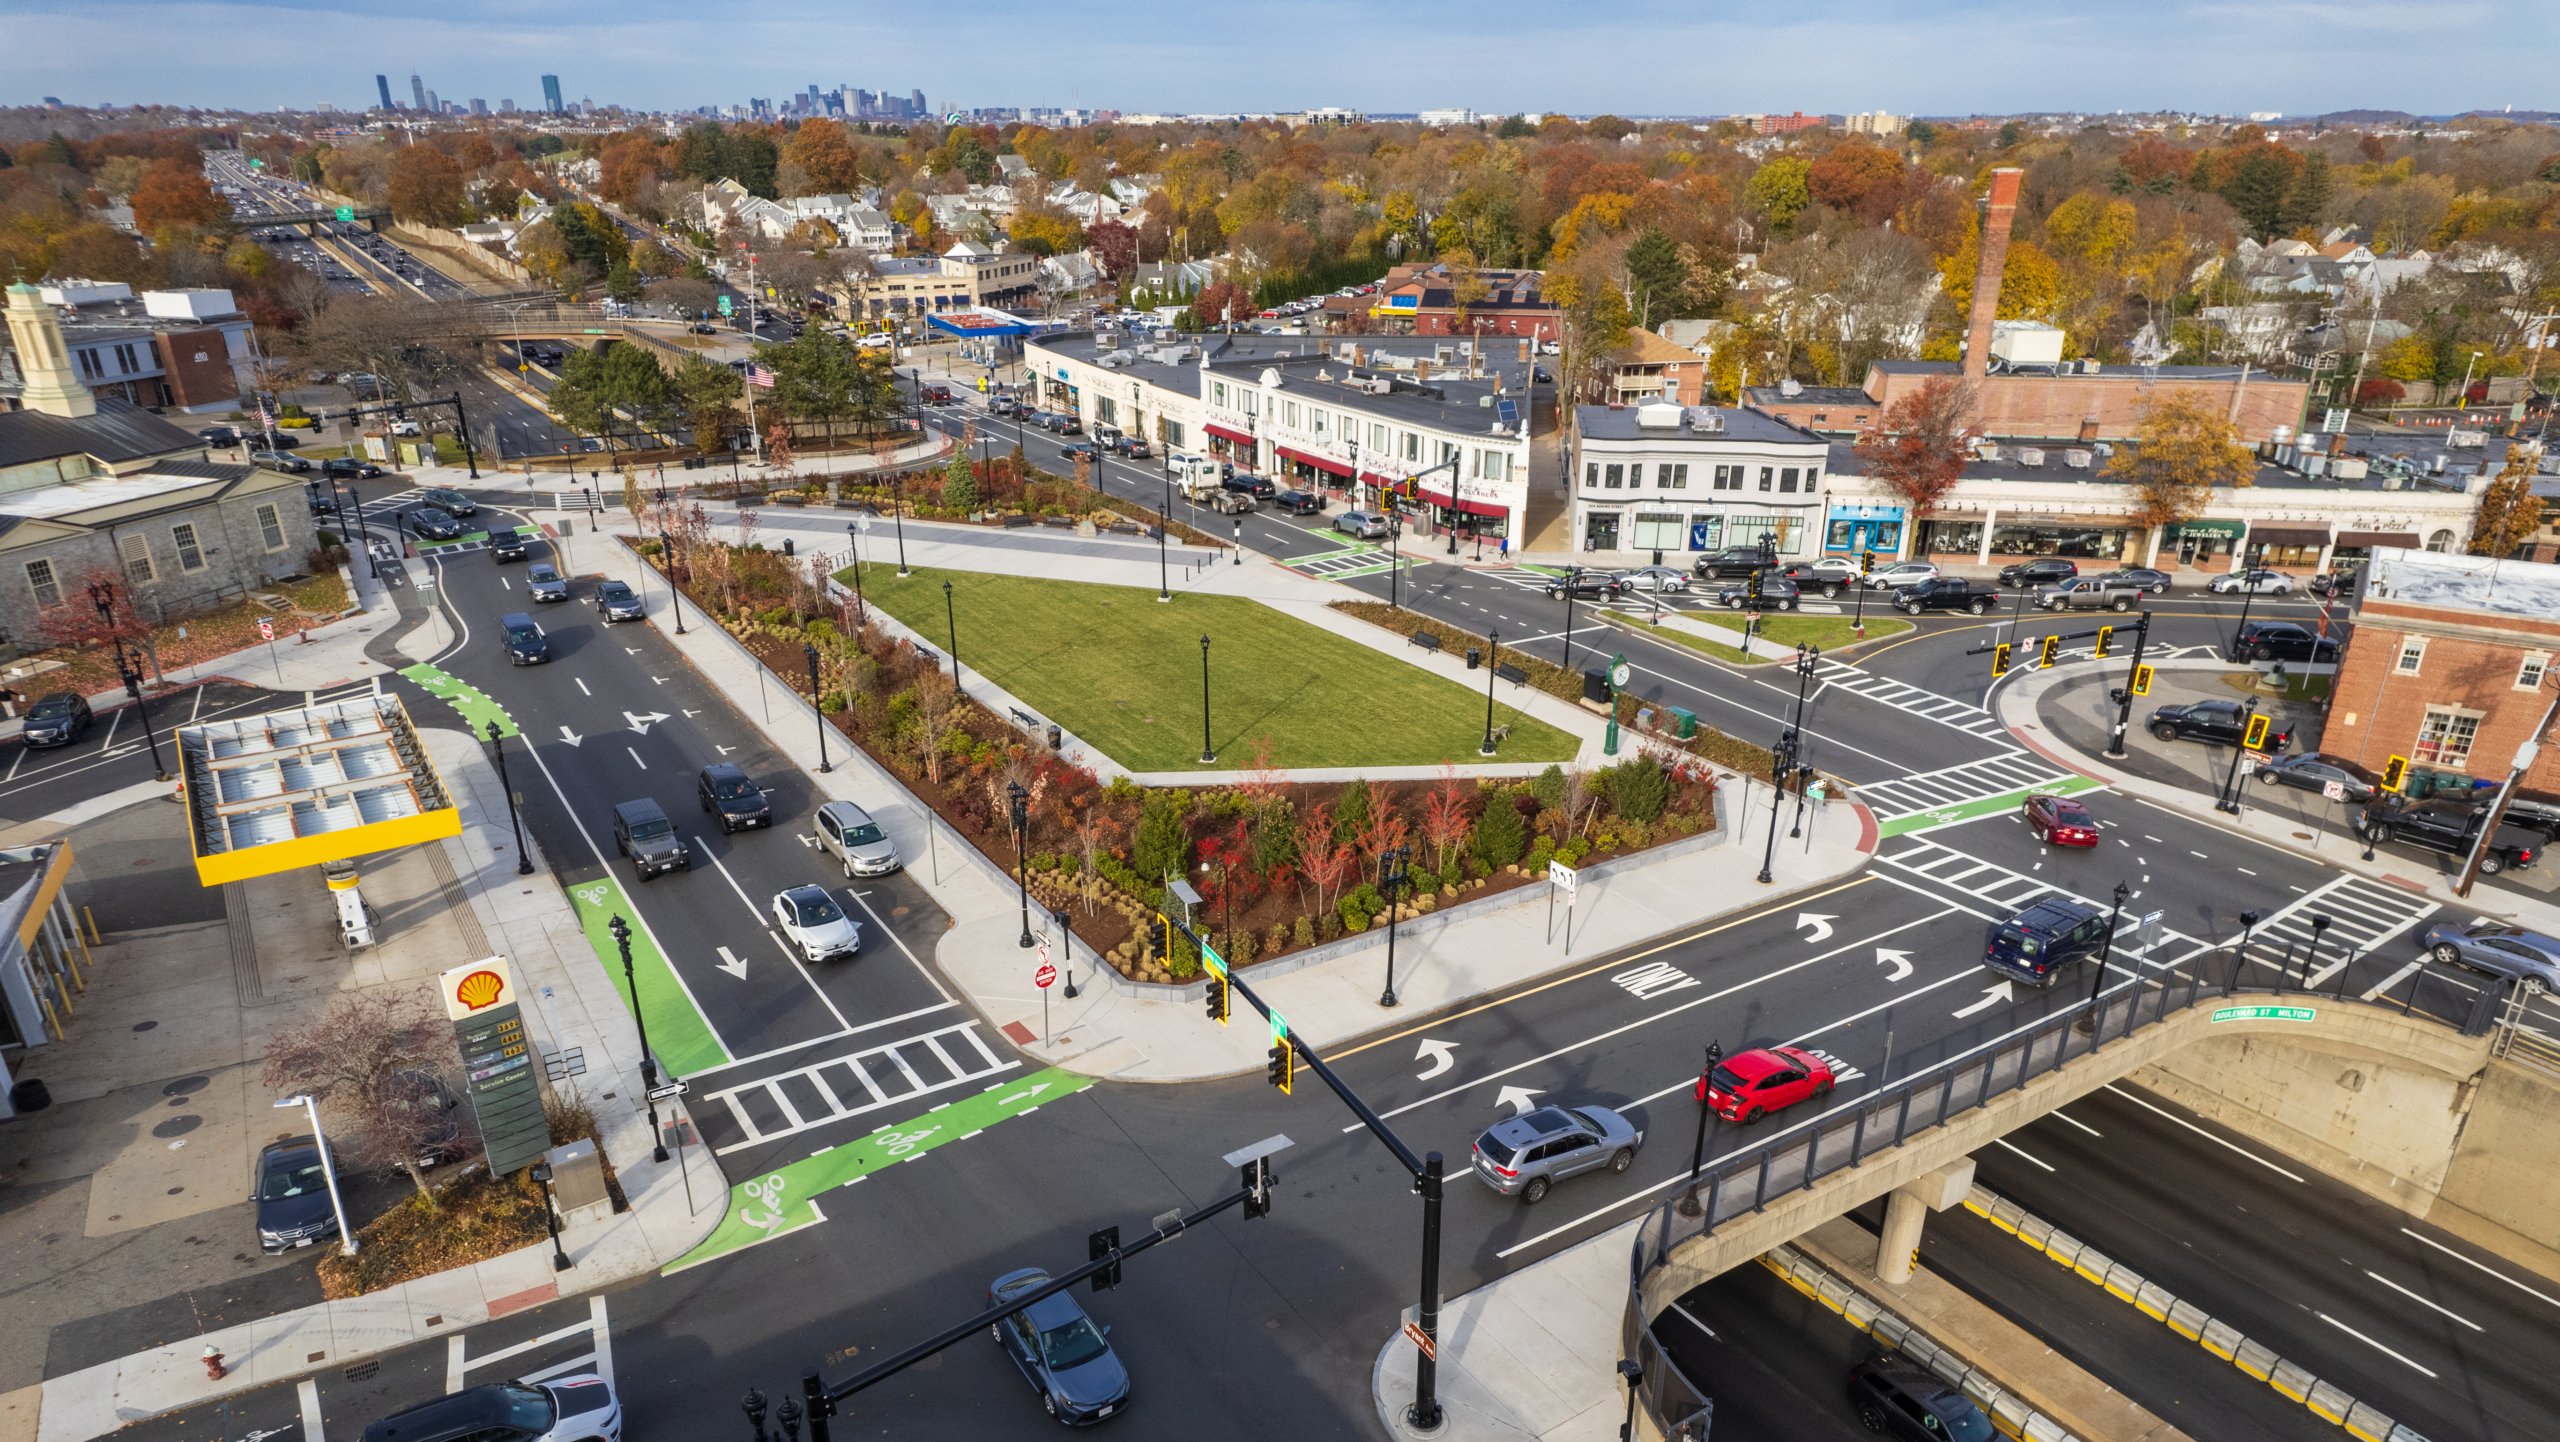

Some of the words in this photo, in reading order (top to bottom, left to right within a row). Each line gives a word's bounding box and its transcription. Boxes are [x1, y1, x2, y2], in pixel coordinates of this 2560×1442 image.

[1464, 487, 1499, 499] CLEANERS
[1610, 961, 1702, 1000] ONLY
[2215, 1008, 2257, 1020] BOULEVARD
[2259, 1008, 2271, 1016] ST
[2277, 1009, 2311, 1019] MILTON
[498, 1021, 514, 1032] 369
[466, 1030, 491, 1040] Regular
[472, 1035, 487, 1043] CASH
[502, 1034, 517, 1044] 449
[505, 1046, 520, 1056] 463
[480, 1079, 504, 1090] Service
[505, 1071, 527, 1081] Center
